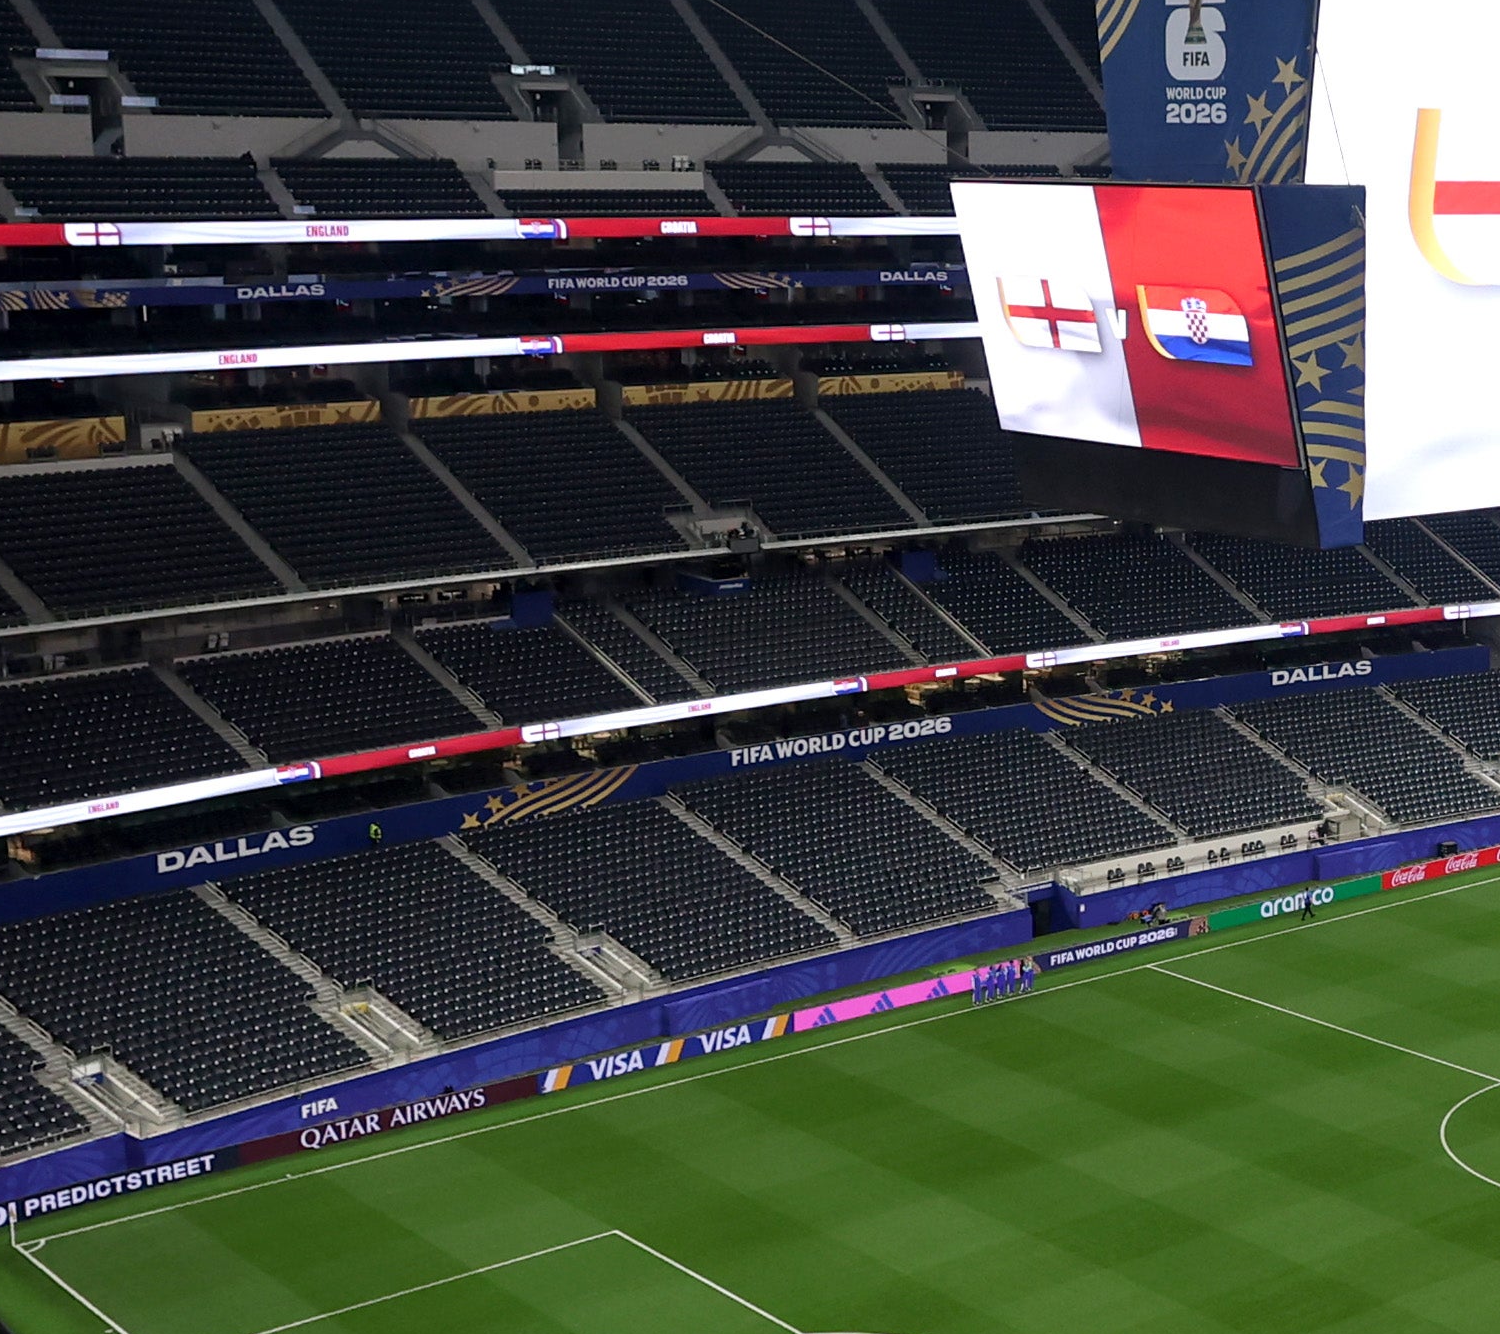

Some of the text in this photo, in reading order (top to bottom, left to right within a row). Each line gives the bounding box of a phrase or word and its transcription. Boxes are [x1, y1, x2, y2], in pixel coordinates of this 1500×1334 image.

[1183, 51, 1210, 67] FIFA
[1166, 86, 1227, 100] WORLD CUP
[1166, 103, 1227, 124] 2026
[305, 225, 349, 237] ENGLAND
[548, 275, 688, 289] FIFA WORLD CUP 2026
[880, 271, 948, 282] DALLAS
[237, 284, 325, 299] DALLAS
[218, 354, 258, 365] ENGLAND
[1271, 661, 1372, 686] DALLAS
[730, 717, 952, 767] FIFA WORLD CUP 2026
[157, 825, 315, 874] DALLAS
[1050, 928, 1174, 967] FIFA WORLD CUP 2026
[700, 1024, 752, 1054] VISA
[588, 1050, 645, 1080] VISA
[301, 1097, 338, 1119] FIFA
[301, 1088, 486, 1149] QATAR AIRWAYS
[24, 1154, 216, 1218] PREDICTSTREET
